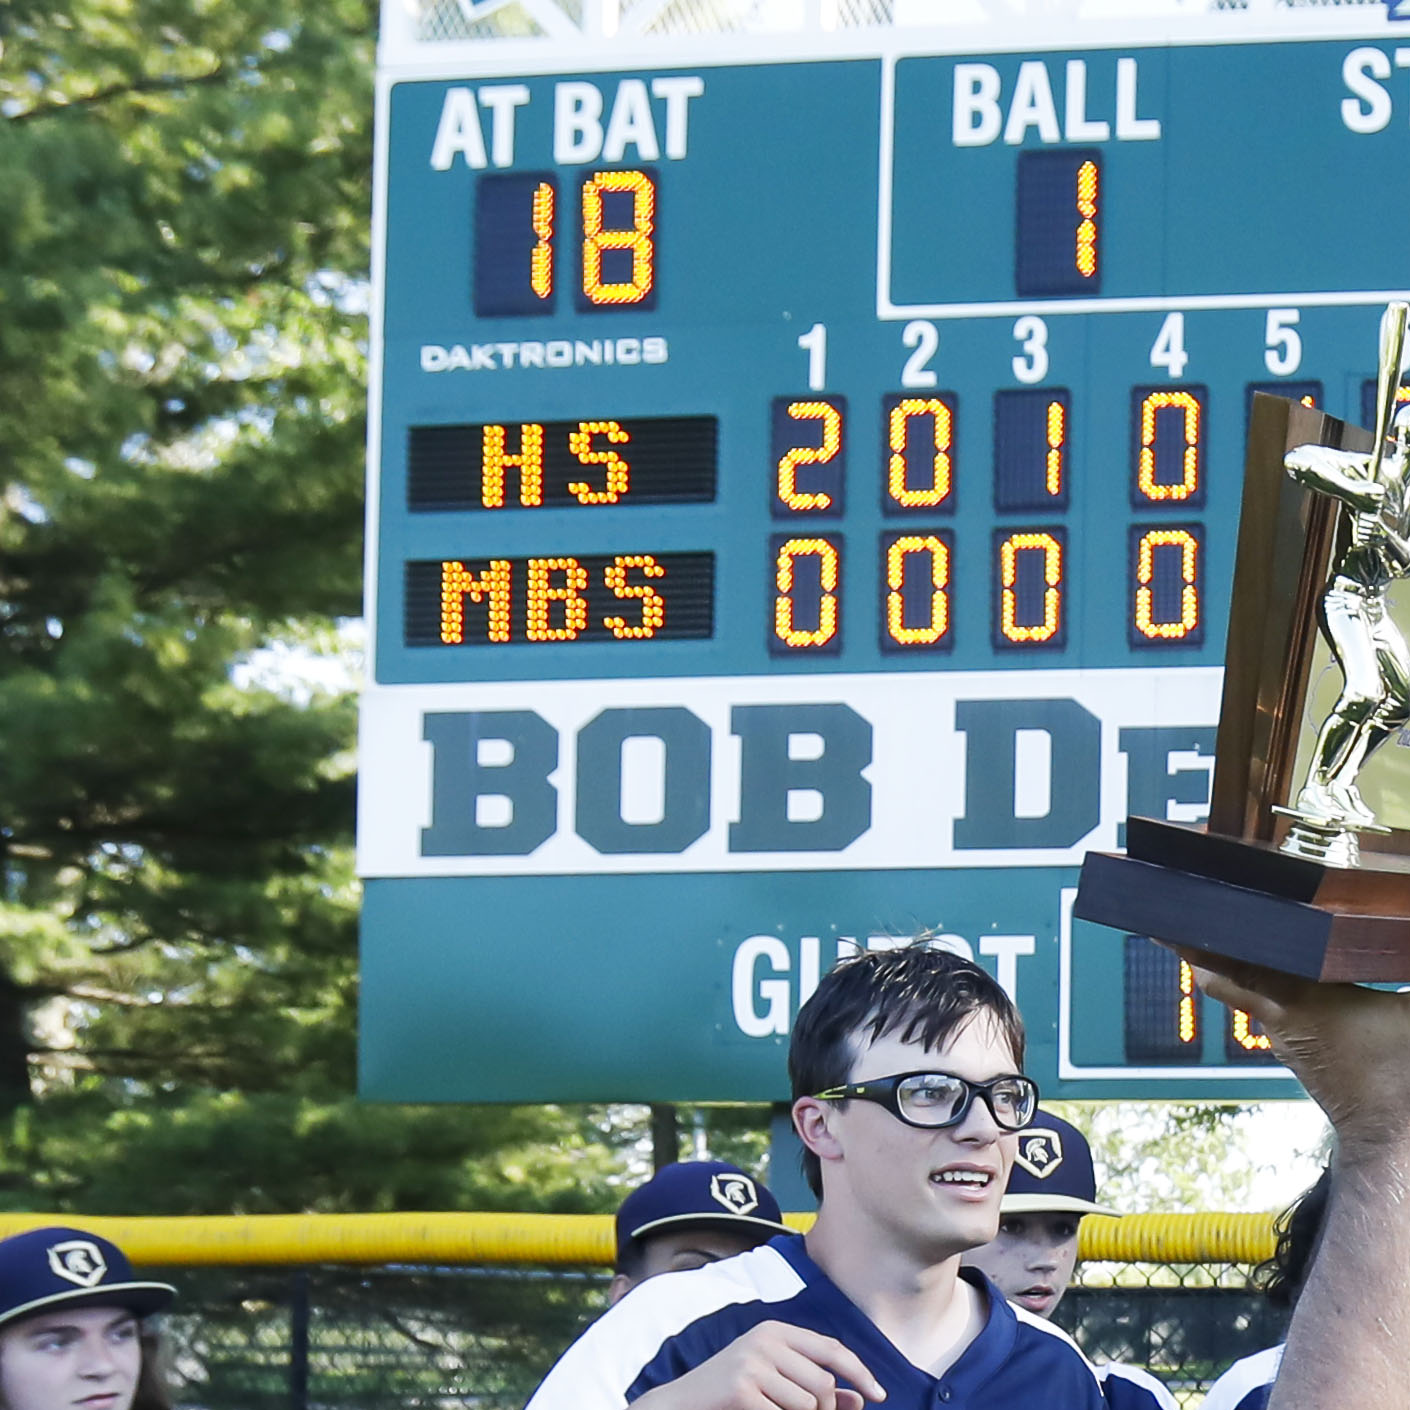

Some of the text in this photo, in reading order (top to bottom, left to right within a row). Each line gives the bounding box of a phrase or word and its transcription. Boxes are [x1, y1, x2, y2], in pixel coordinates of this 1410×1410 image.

[431, 77, 704, 170] AT BAT
[952, 59, 1161, 146] BALL
[530, 170, 656, 305] 18
[1077, 161, 1098, 277] 1
[420, 336, 668, 372] DAKTRONICS
[798, 323, 826, 391] 1
[901, 321, 939, 388] 2
[1012, 317, 1048, 384] 3
[1150, 313, 1188, 378] 4
[1264, 308, 1302, 376] 5
[481, 421, 630, 509] HS
[777, 401, 843, 511] 2
[888, 398, 953, 508] 0
[1046, 402, 1065, 496] 1
[1138, 392, 1201, 502] 0
[440, 555, 665, 644] MBS
[775, 538, 839, 648] 0
[887, 535, 951, 645] 0
[1000, 533, 1063, 643] 0
[1135, 530, 1200, 639] 0
[420, 702, 874, 857] BOB
